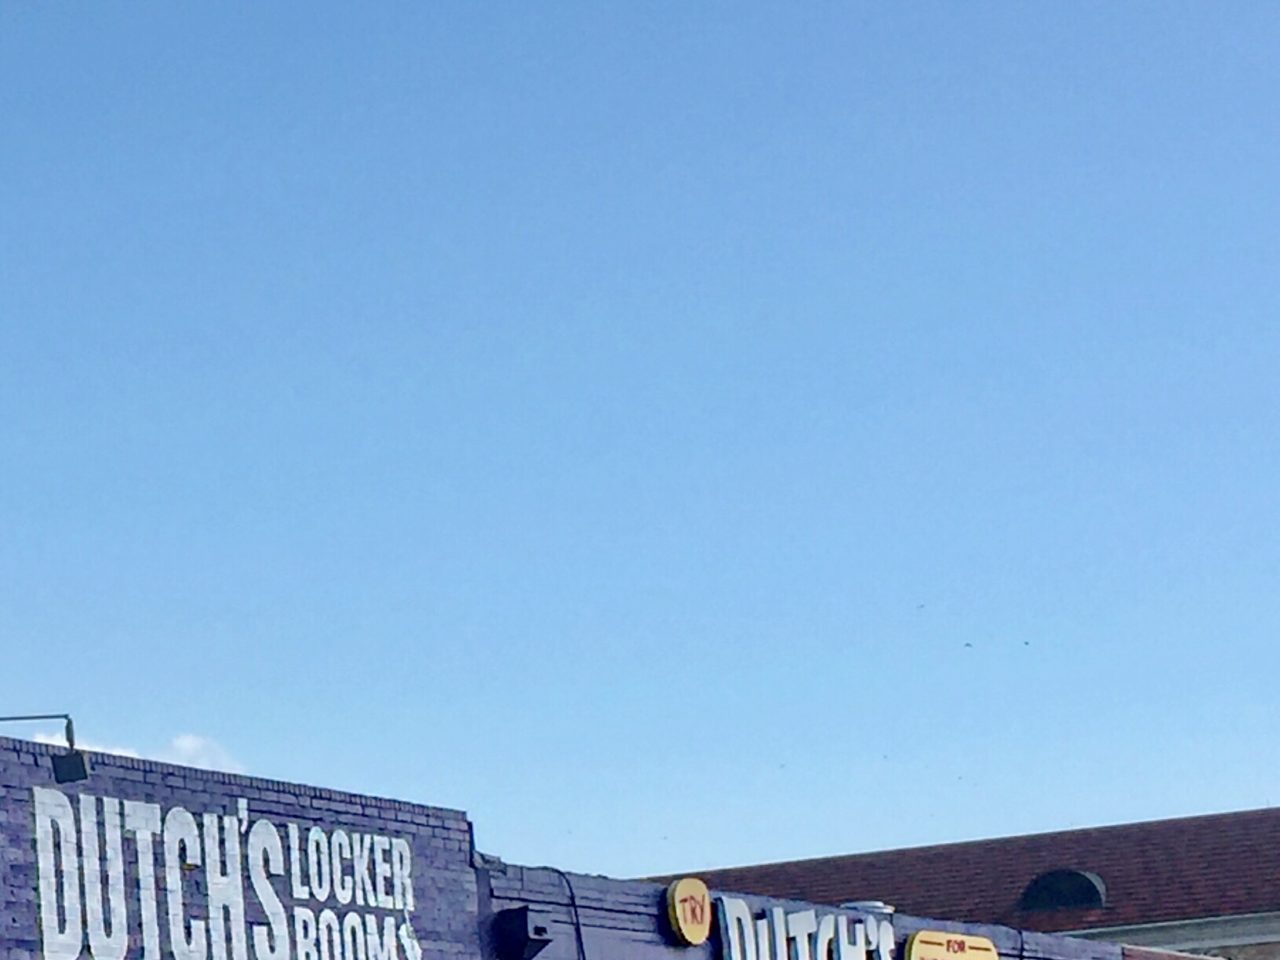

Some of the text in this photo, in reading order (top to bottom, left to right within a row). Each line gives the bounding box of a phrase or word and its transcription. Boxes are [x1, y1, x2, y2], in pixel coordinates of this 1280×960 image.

[287, 822, 414, 911] LOCKER
[679, 894, 706, 925] TRY
[945, 939, 967, 954] FOR
